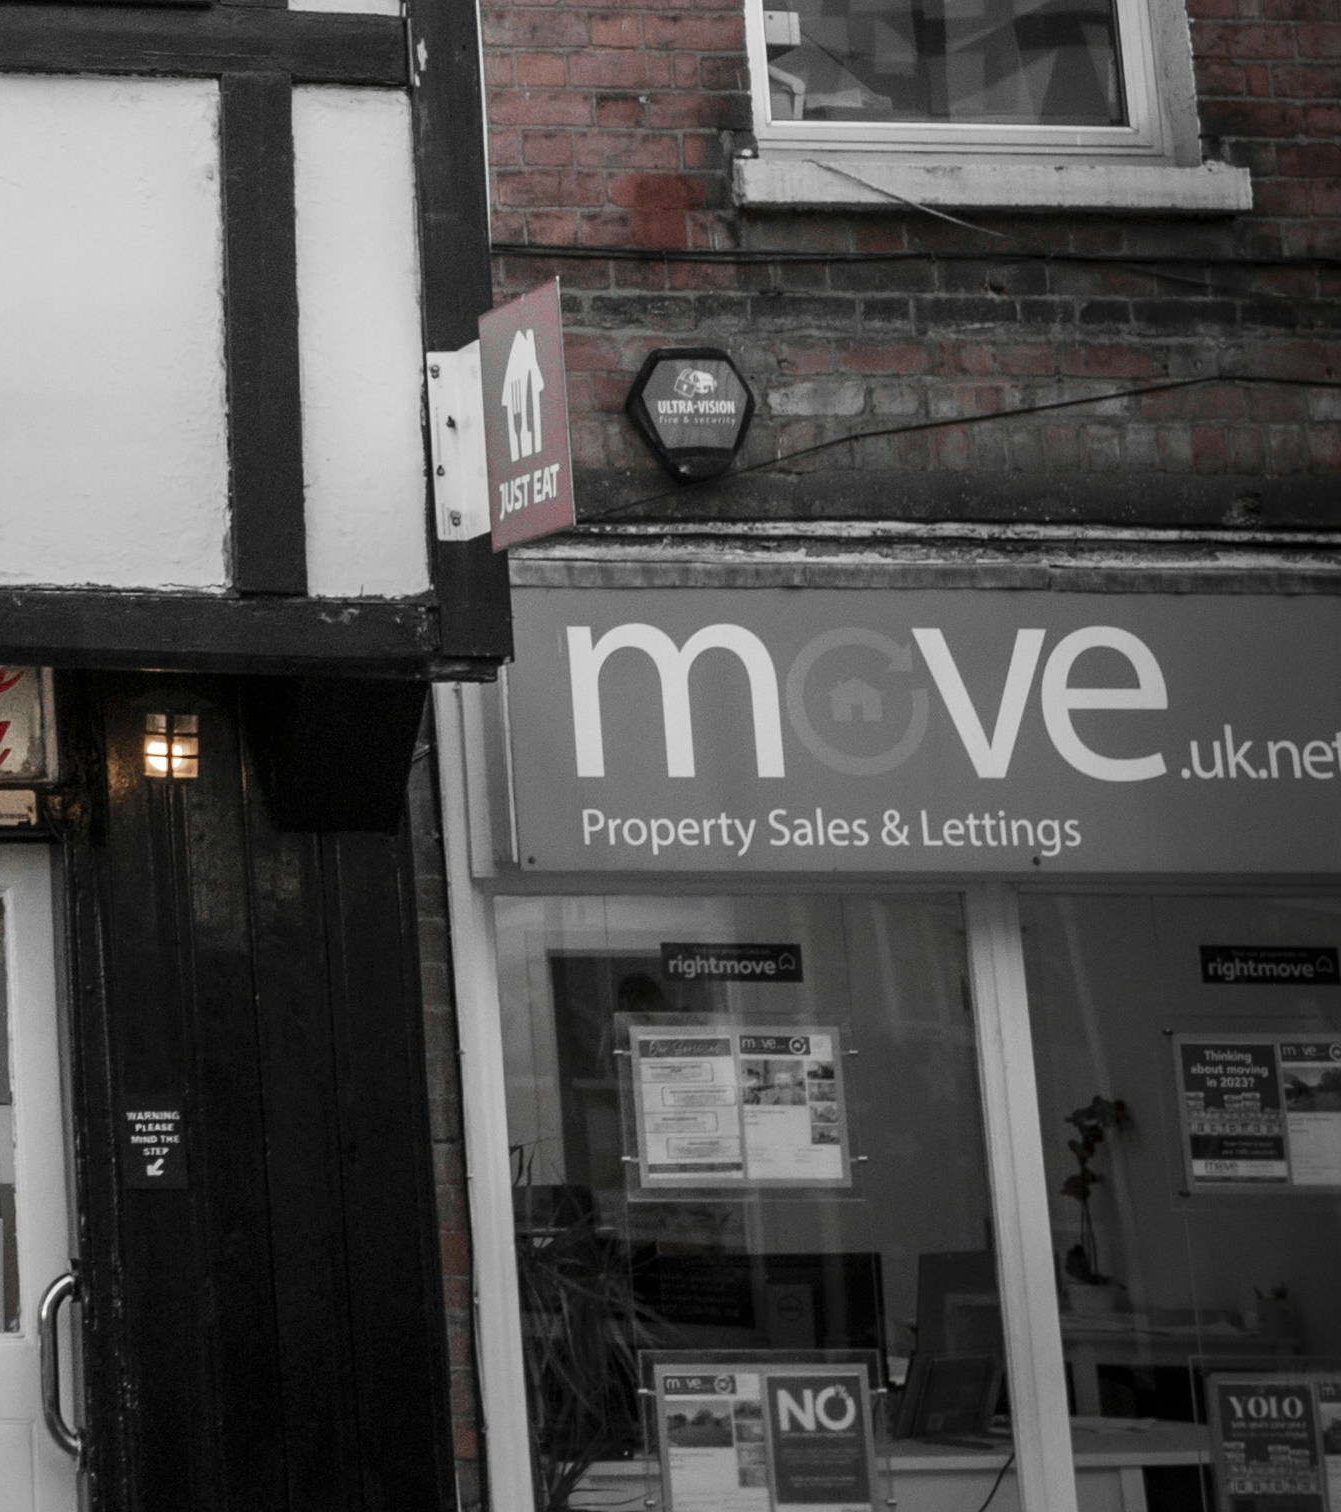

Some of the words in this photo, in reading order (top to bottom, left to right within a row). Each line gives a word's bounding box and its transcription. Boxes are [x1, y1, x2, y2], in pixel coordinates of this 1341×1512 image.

[657, 399, 736, 415] ULTRA-VISION
[658, 415, 679, 425] fire
[682, 415, 690, 425] &
[694, 416, 736, 427] security
[499, 475, 531, 522] JUST
[533, 464, 560, 505] EAT
[580, 807, 758, 857] Property
[768, 807, 870, 848] Sales
[880, 809, 910, 848] &
[921, 808, 1083, 856] Lettings
[668, 954, 777, 979] rightmove
[1207, 956, 1316, 981] rightmove
[1204, 1049, 1252, 1065] Thinking
[1190, 1063, 1224, 1075] about
[1226, 1064, 1269, 1078] moving
[1206, 1077, 1218, 1088] in
[1220, 1076, 1255, 1088] 2023?
[125, 1111, 181, 1121] WARNING
[134, 1123, 175, 1133] PLEASE
[130, 1135, 159, 1144] MIND
[159, 1134, 181, 1144] THE
[143, 1146, 170, 1156] STEP
[776, 1383, 857, 1432] NO
